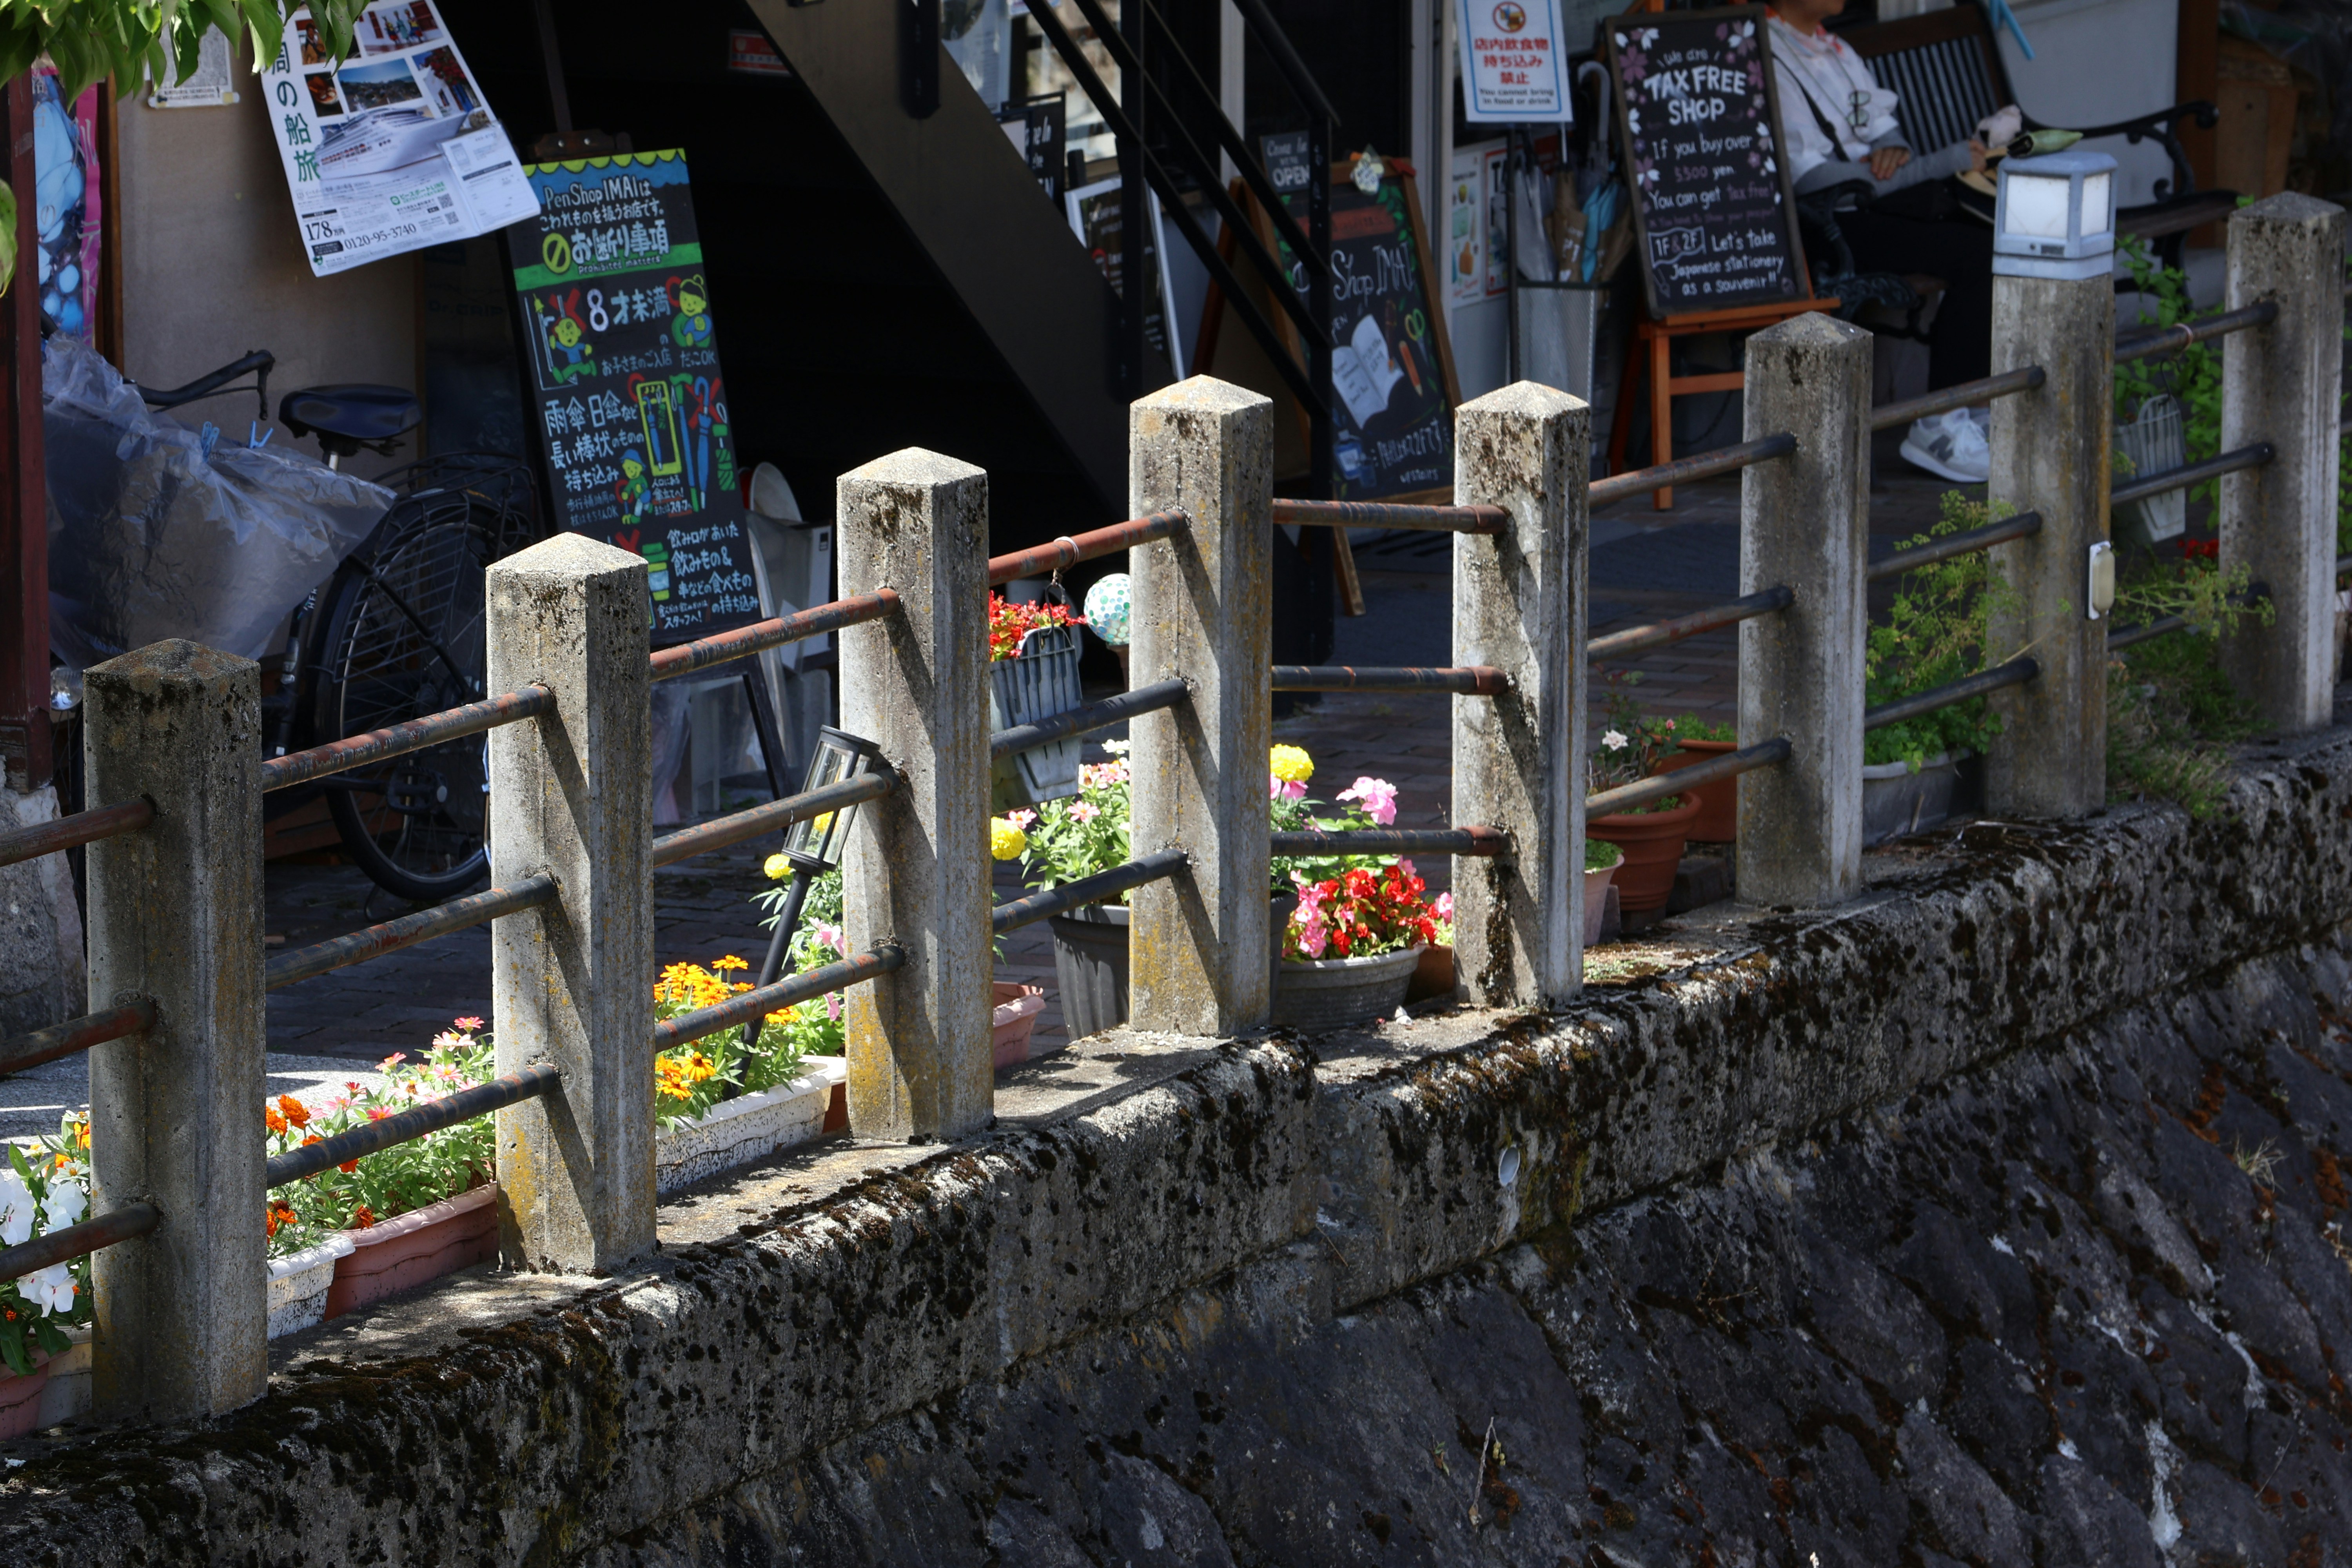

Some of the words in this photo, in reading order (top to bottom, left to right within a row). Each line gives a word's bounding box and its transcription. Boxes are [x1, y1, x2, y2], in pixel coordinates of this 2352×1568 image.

[1474, 37, 1549, 51] 店内飲食物
[1483, 54, 1543, 68] 持ち込み
[1500, 71, 1530, 85] 禁止
[1643, 69, 1690, 101] TAX
[1691, 64, 1747, 96] FREE
[1668, 96, 1726, 126] SHOP
[1674, 142, 1697, 160] you
[1699, 132, 1723, 156] buy
[1725, 135, 1753, 151] over
[1273, 164, 1310, 187] OPEN
[1648, 189, 1674, 210] You
[1675, 192, 1698, 207] can
[1700, 185, 1721, 210] get
[344, 223, 417, 250] 0120-95-3740
[571, 219, 669, 264] お断り事項
[1711, 230, 1744, 252] Let's
[1746, 228, 1777, 249] take
[625, 255, 661, 267] matters
[1670, 260, 1721, 281] Japanese
[1724, 254, 1784, 274] stationery
[1331, 249, 1374, 307] Shop
[1682, 282, 1698, 296] as
[1702, 281, 1713, 294] a
[602, 347, 672, 376] お子さまのご入店
[550, 428, 644, 469] 長い棒状のものの
[564, 463, 619, 492] 持ち込み
[678, 570, 752, 599] 串などの食べもの
[711, 593, 759, 614] の持ち込み
